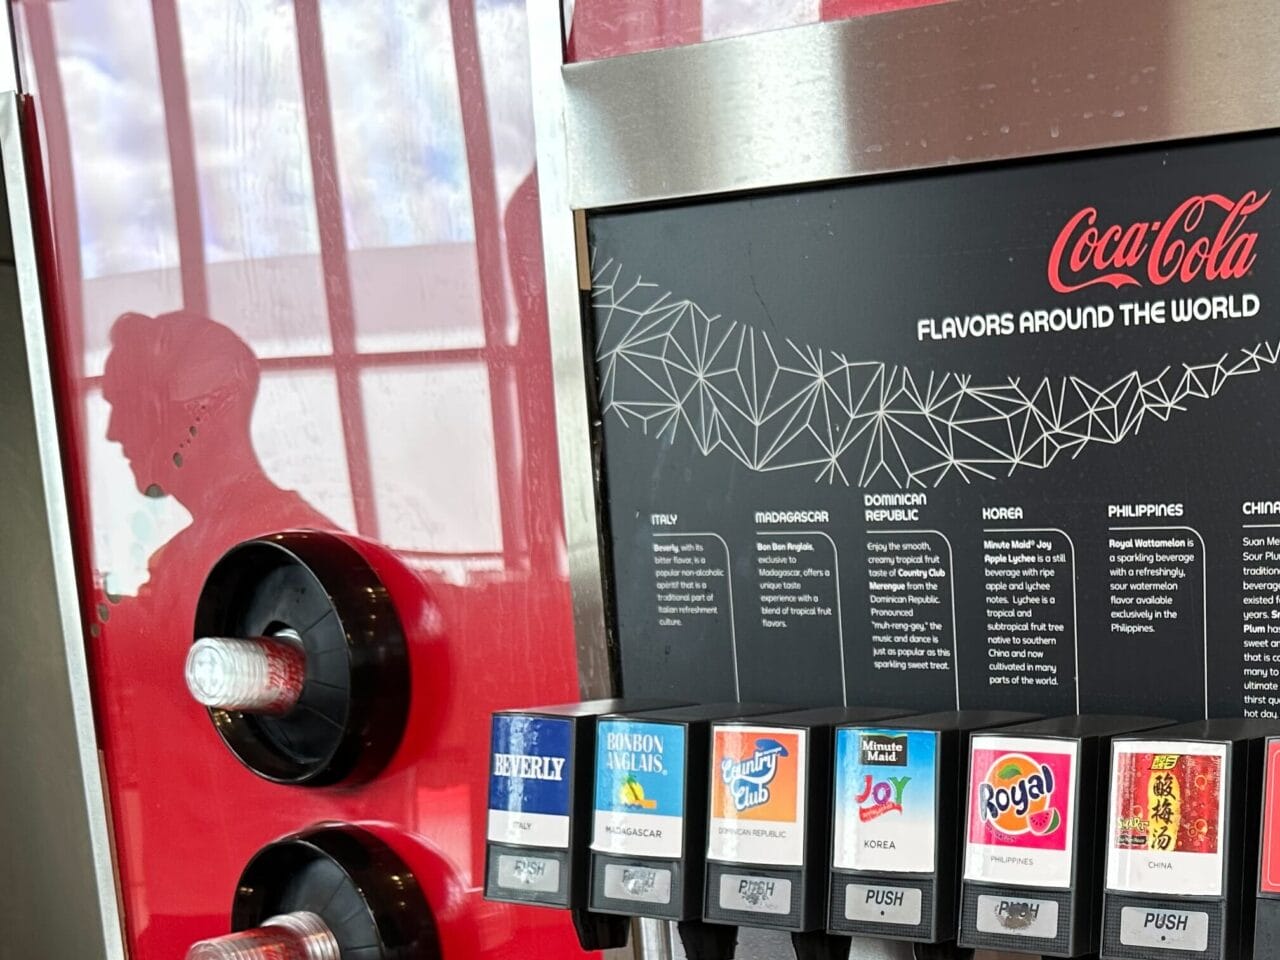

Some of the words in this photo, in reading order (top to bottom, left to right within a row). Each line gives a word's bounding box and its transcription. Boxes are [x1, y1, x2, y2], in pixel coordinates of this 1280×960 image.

[1047, 189, 1272, 294] Coca-Cola
[917, 312, 1015, 341] FLAVORS
[1019, 306, 1114, 334] AROUND
[1119, 301, 1166, 326] THE
[1171, 294, 1261, 323] WORLD
[864, 493, 927, 506] DOMINICAN
[865, 509, 919, 521] REPUBLIC
[982, 507, 1023, 520] KOREA
[1108, 503, 1184, 518] PHILIPPINES
[651, 513, 678, 526] ITALY
[755, 511, 830, 524] MADAGASCAR
[866, 542, 887, 552] Enjoy
[888, 542, 900, 550] the
[901, 541, 931, 550] smooth,
[983, 540, 1010, 549] Minute
[1036, 540, 1052, 550] Joy
[1108, 538, 1133, 550] Royal
[1134, 537, 1185, 547] Wattamelon
[1186, 538, 1194, 547] is
[1242, 536, 1265, 546] Suan
[984, 554, 1007, 564] Apple
[1007, 553, 1036, 564] Lychee
[1052, 554, 1066, 562] still
[1116, 553, 1154, 563] sparkling
[1155, 552, 1194, 563] beverage
[1242, 551, 1263, 561] Sour
[888, 568, 896, 576] of
[897, 568, 927, 578] Country
[928, 568, 945, 577] Club
[984, 568, 1020, 578] beverage
[1021, 567, 1038, 576] with
[1039, 568, 1055, 578] ripe
[1109, 567, 1126, 576] with
[1135, 567, 1186, 578] refreshingly,
[1129, 581, 1178, 590] watermelon
[1242, 595, 1274, 604] existed
[607, 732, 664, 753] BONBON
[862, 740, 903, 752] Minute
[867, 750, 897, 762] Maid
[493, 753, 566, 781] BEVERLY
[721, 746, 783, 783] Country
[730, 777, 770, 811] Club
[854, 774, 912, 804] JOY
[980, 764, 1054, 822] Royal
[1151, 773, 1176, 851] 酸梅汤
[605, 826, 662, 839] MADAGASCAR
[752, 829, 787, 838] REPUBLIC
[864, 840, 896, 849] KOREA
[990, 856, 1034, 866] PHILIPPINES
[1148, 861, 1172, 870] CHINA
[865, 889, 904, 907] PUSH
[1144, 912, 1188, 931] PUSH
